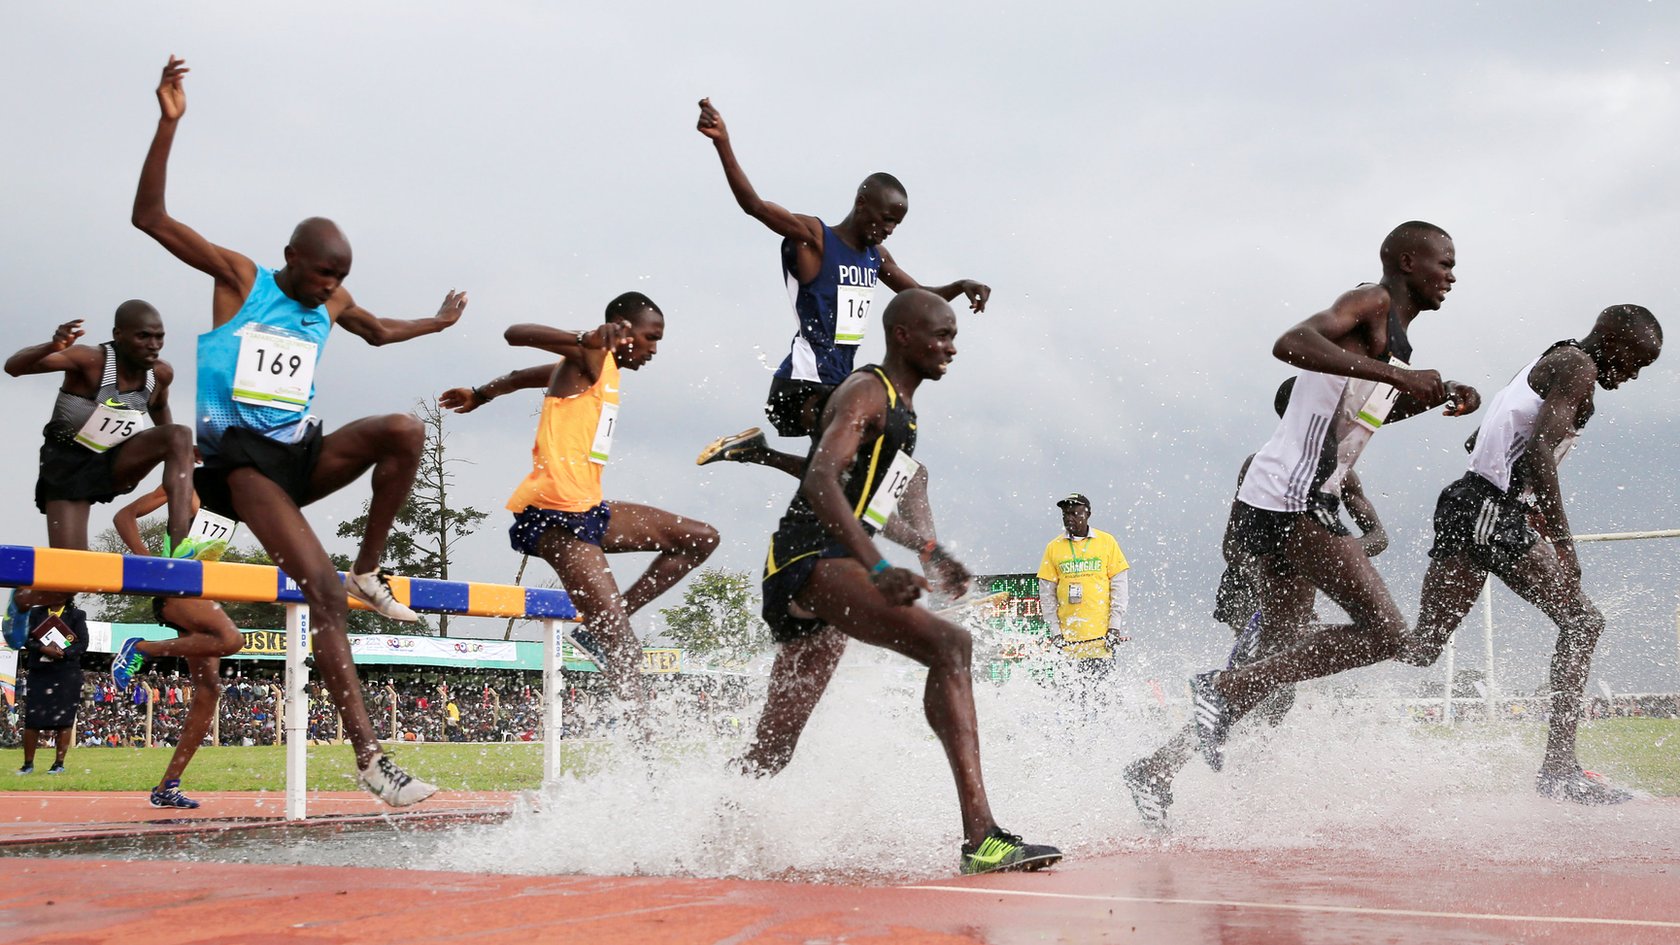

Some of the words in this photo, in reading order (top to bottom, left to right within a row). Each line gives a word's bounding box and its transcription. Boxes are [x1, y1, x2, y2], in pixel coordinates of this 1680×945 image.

[848, 299, 871, 318] 167
[256, 348, 302, 378] 169
[99, 417, 136, 437] 175
[202, 520, 228, 539] 177
[243, 631, 288, 650] USKE
